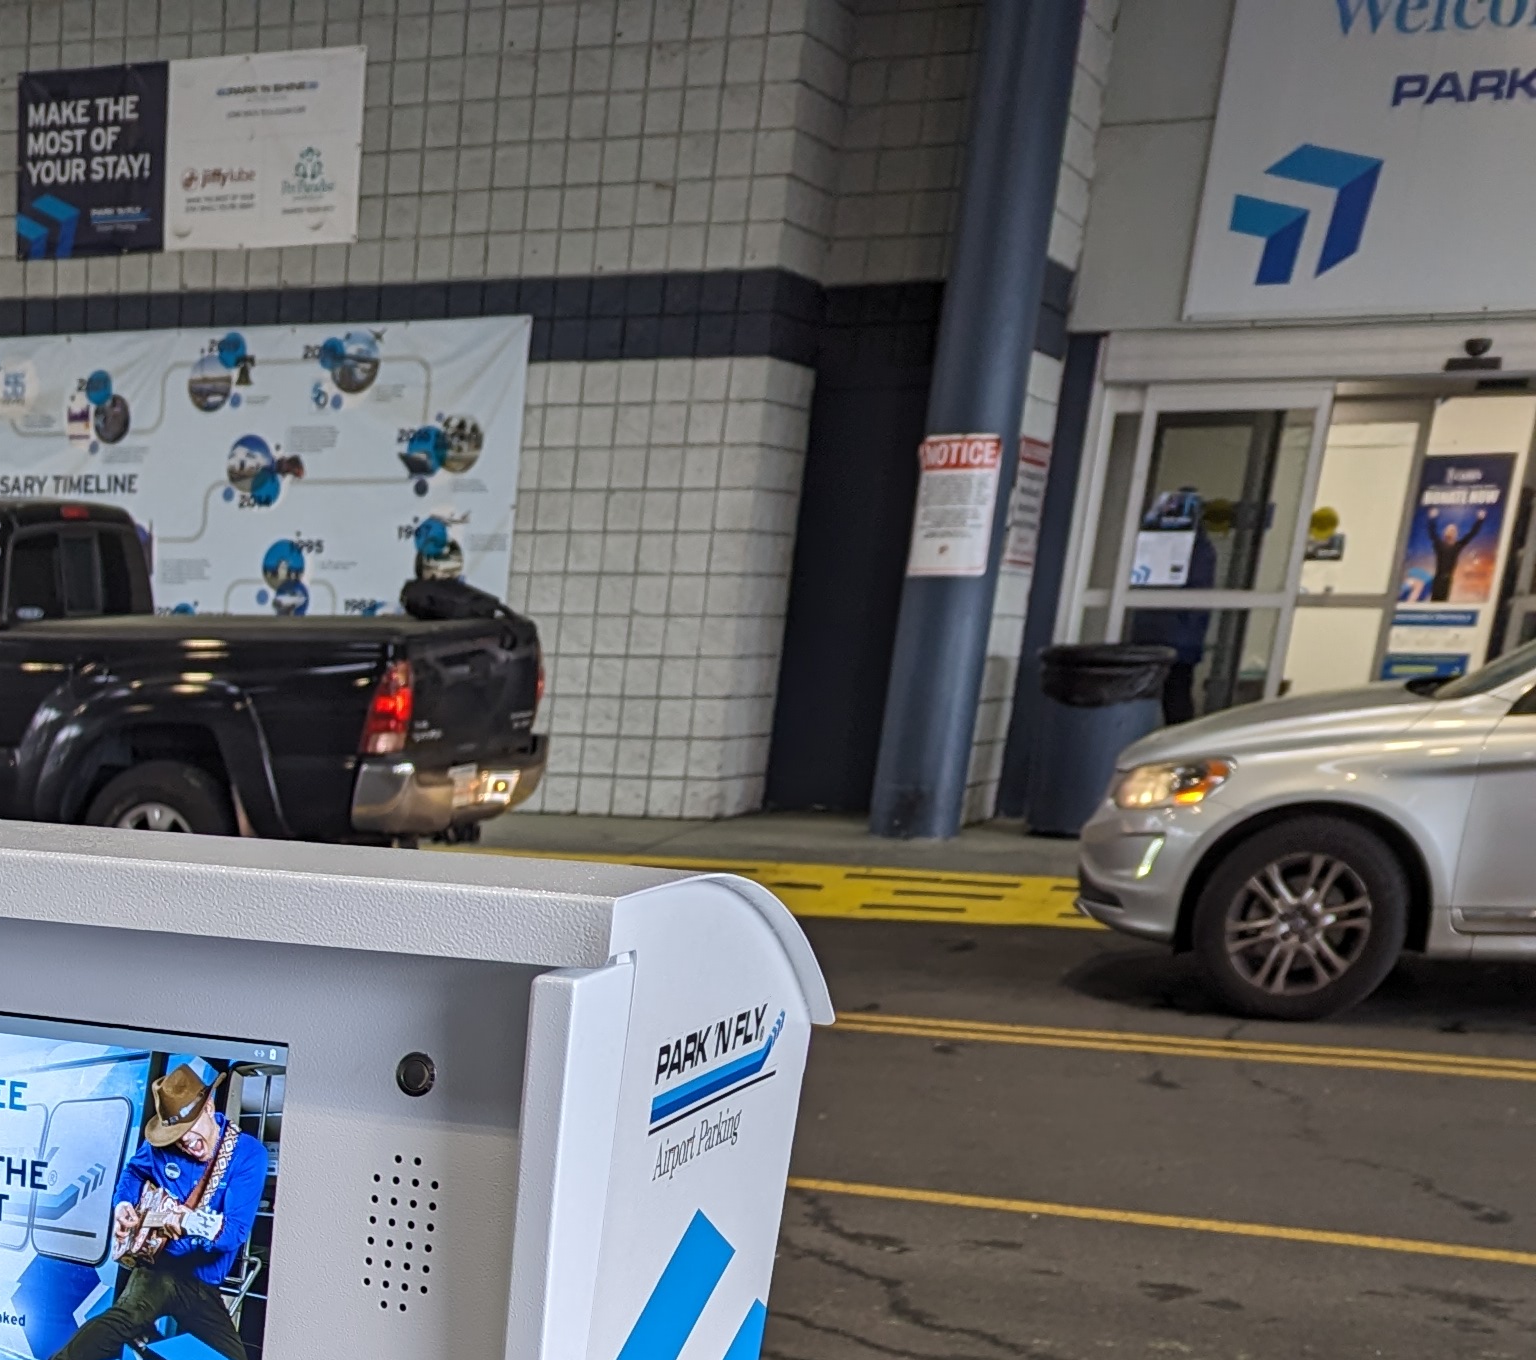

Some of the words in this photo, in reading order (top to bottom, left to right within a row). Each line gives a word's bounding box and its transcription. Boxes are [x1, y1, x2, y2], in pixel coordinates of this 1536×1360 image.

[1336, 0, 1536, 36] Welco
[1391, 68, 1536, 107] PARK
[27, 99, 91, 128] MAKE
[94, 95, 140, 122] THE
[27, 129, 87, 157] MOST
[90, 126, 122, 152] OF
[27, 157, 86, 186] YOUR
[90, 152, 151, 182] STAY!
[924, 440, 998, 466] NOTICE
[52, 473, 139, 494] TIMELINE
[654, 1025, 712, 1086] PARK
[732, 1002, 768, 1051] FLY
[651, 1127, 696, 1182] Airport
[696, 1109, 743, 1157] Parking
